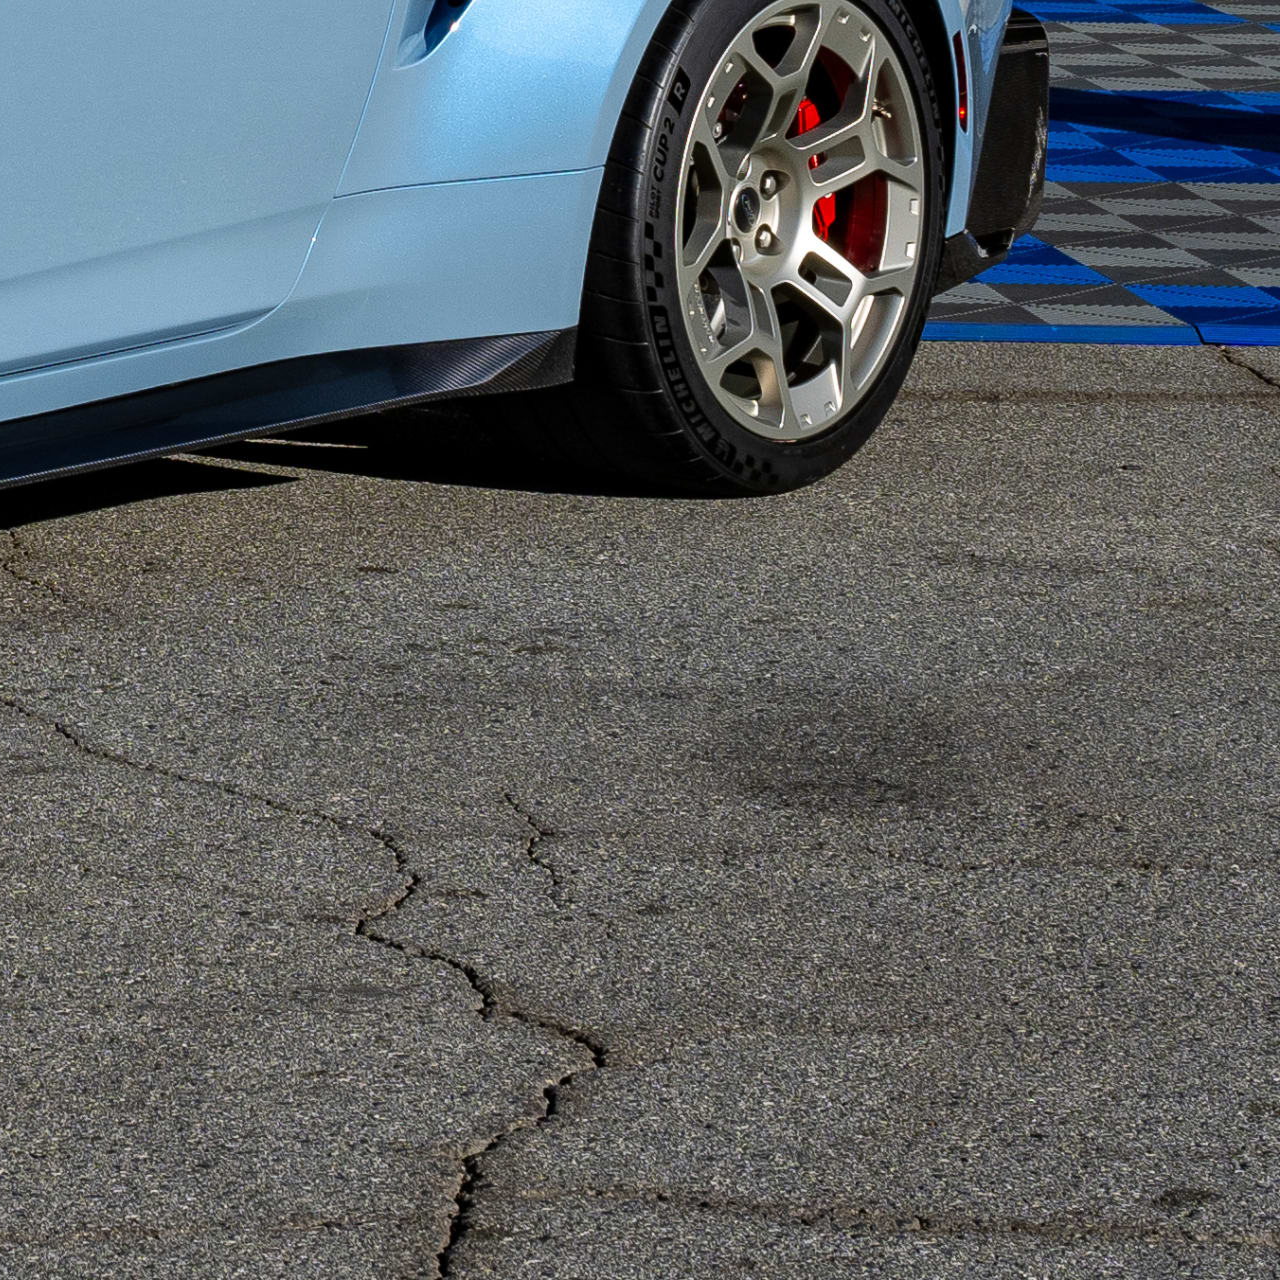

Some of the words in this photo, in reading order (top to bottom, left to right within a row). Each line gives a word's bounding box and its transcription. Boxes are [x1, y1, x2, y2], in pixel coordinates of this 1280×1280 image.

[653, 133, 669, 183] CUP
[663, 117, 675, 135] 2
[653, 314, 717, 441] MICHELIN
